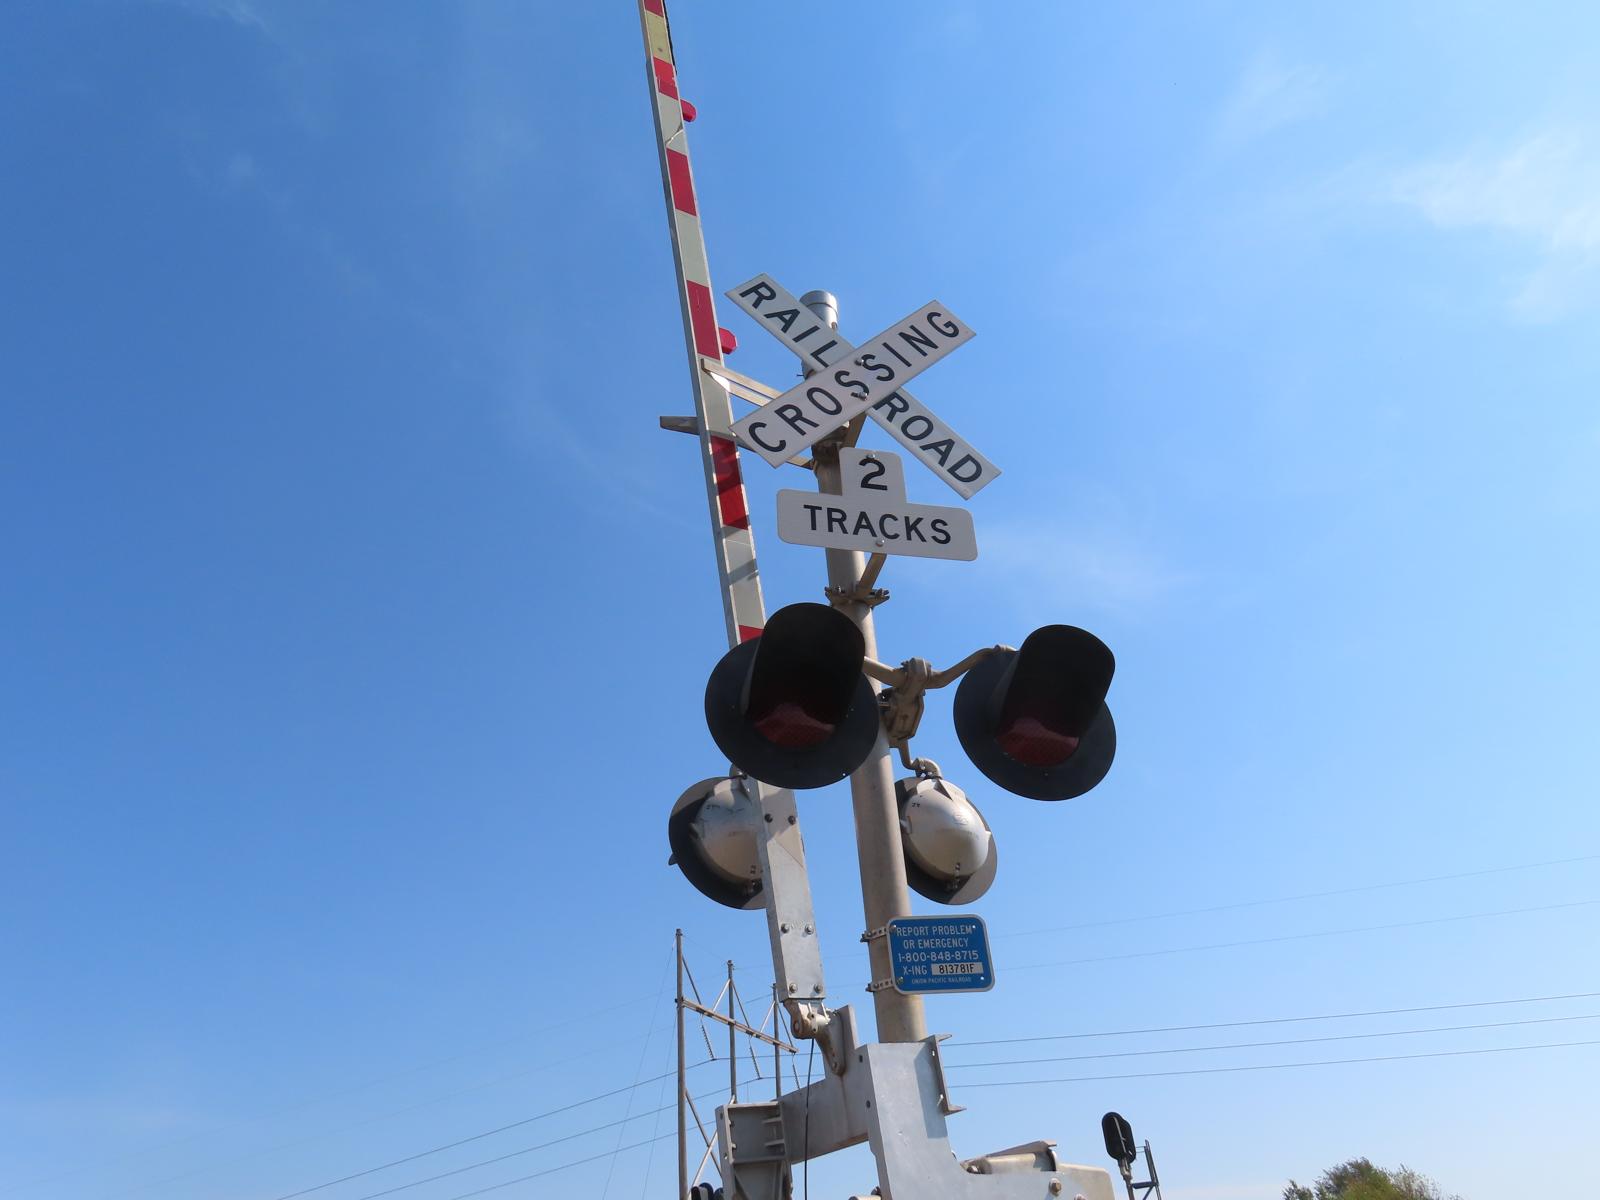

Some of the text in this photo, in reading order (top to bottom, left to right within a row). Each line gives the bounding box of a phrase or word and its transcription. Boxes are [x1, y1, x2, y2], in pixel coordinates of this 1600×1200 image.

[739, 281, 983, 483] RAIL ROAD
[748, 311, 960, 453] CROSSING
[858, 458, 888, 491] 2
[803, 504, 952, 545] TRACKS
[896, 924, 973, 937] REPORT PROBLEM
[903, 937, 969, 949] OR EMERGENCY
[898, 950, 979, 962] 1-800-848-8715
[903, 963, 974, 976] X-ING 813781F
